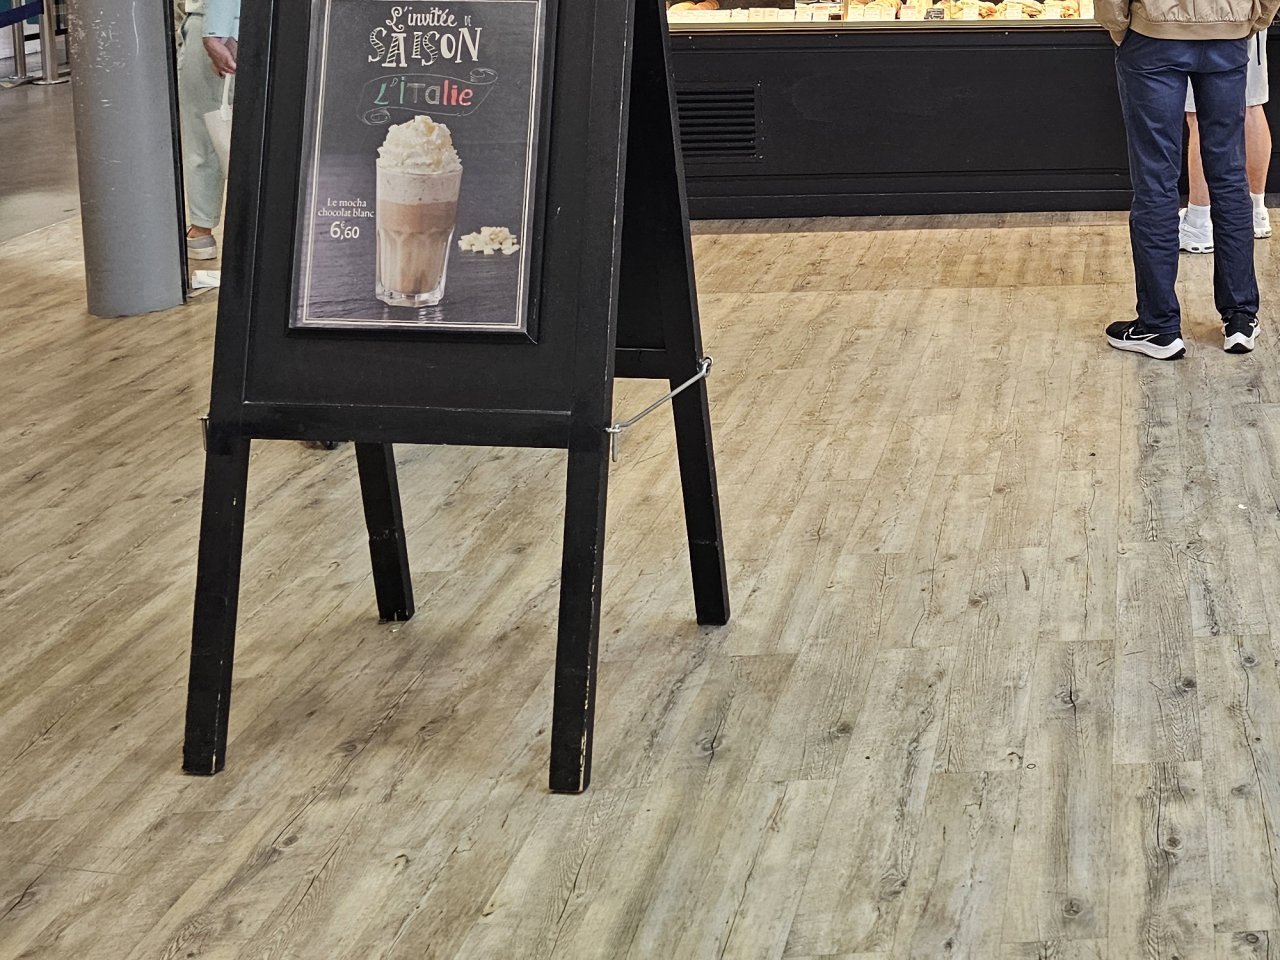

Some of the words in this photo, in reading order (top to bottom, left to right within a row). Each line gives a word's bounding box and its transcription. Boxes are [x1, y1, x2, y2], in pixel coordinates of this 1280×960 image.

[386, 6, 458, 31] L'invitée
[464, 15, 472, 27] DE
[368, 27, 482, 68] SAISON
[327, 197, 338, 207] Le
[339, 198, 367, 208] mocha
[317, 208, 351, 217] chocolat
[352, 208, 375, 218] blanc
